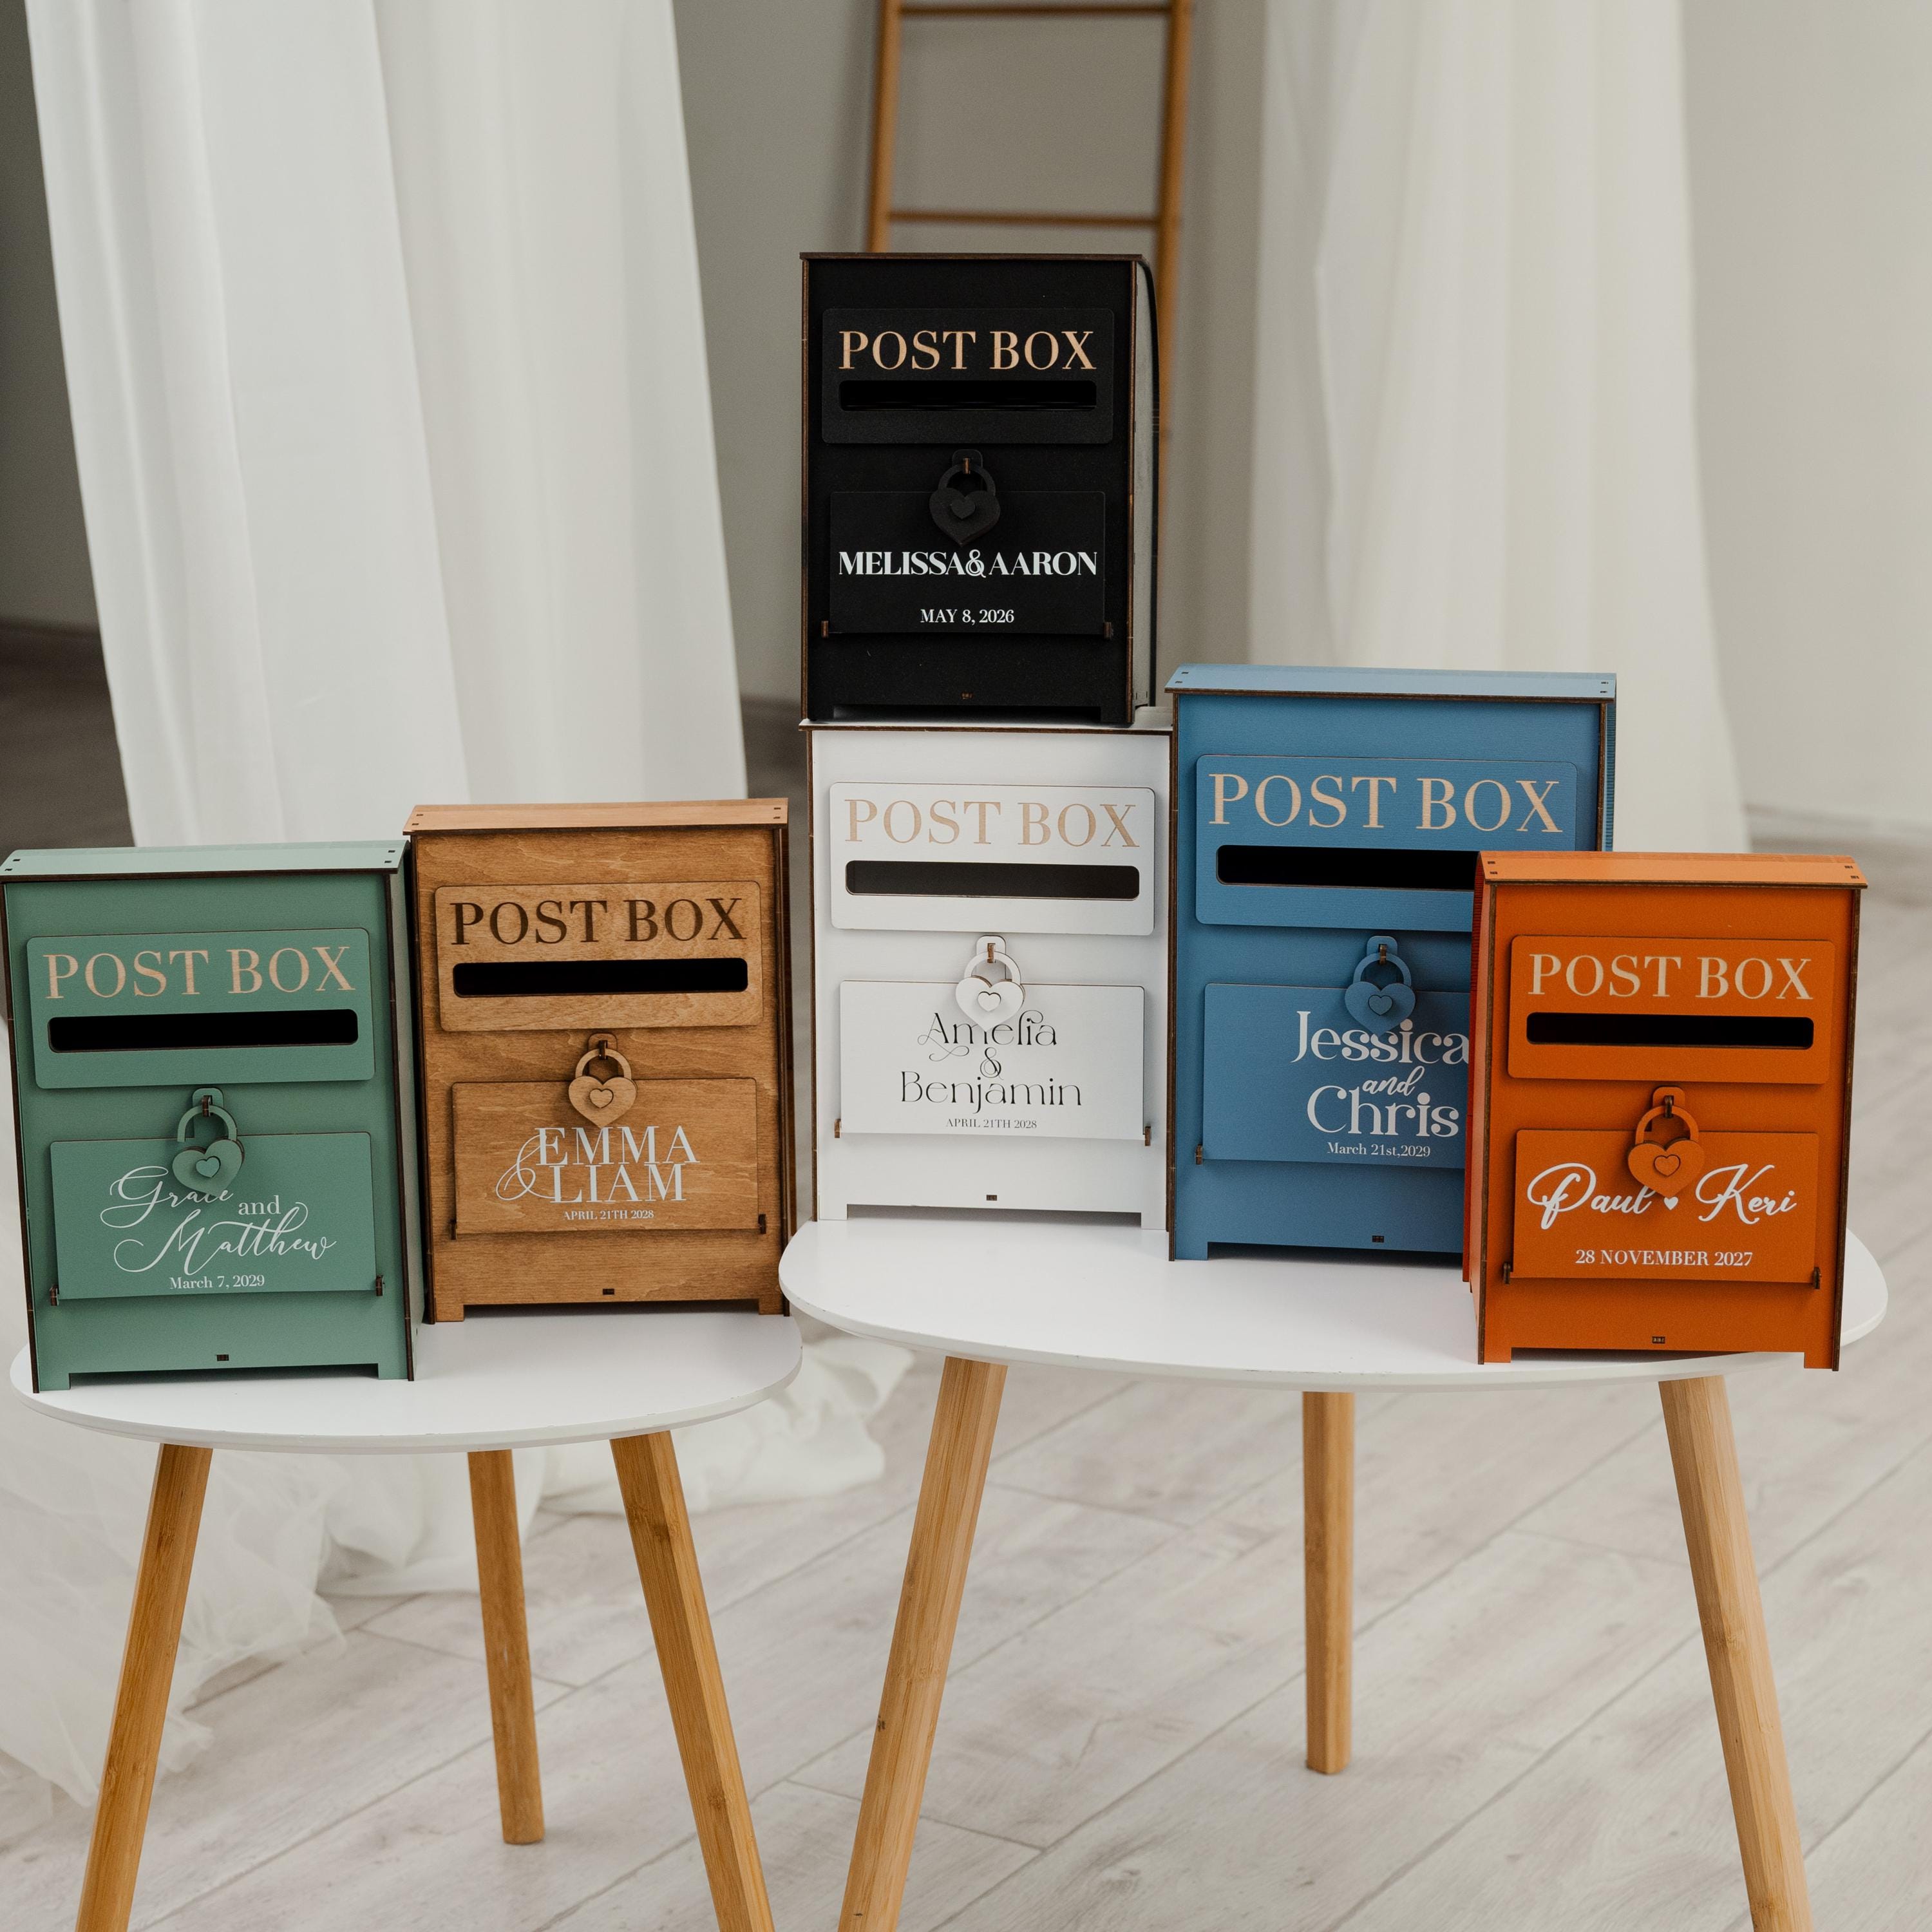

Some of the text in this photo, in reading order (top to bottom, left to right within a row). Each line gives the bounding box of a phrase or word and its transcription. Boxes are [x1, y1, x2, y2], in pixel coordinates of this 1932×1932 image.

[838, 330, 1096, 370] POST BOX
[920, 609, 1015, 625] MAY 8, 2026
[1208, 773, 1563, 833] POST BOX
[844, 799, 1141, 849] POST BOX
[450, 898, 747, 945] POST BOX
[43, 946, 355, 999] POST BOX
[1528, 953, 1814, 1000] POST BOX
[1291, 1010, 1470, 1065] Jessica
[980, 1046, 1004, 1081] &
[1362, 1065, 1425, 1096] and
[901, 1071, 1081, 1114] Benjamin
[1307, 1085, 1459, 1137] Chris
[945, 1118, 1037, 1129] APRIL 21TH 2028
[535, 1125, 701, 1166] EMMA
[1327, 1142, 1431, 1157] March 21st,2029
[548, 1163, 687, 1204] LIAM
[1526, 1162, 1797, 1229] Paul Keri
[238, 1195, 281, 1215] and
[564, 1210, 655, 1220] APRIL 21TH 2028
[114, 1201, 337, 1276] Matthew
[1575, 1249, 1754, 1267] 28 NOVEMBER 2027
[169, 1274, 265, 1289] March 7, 2029
